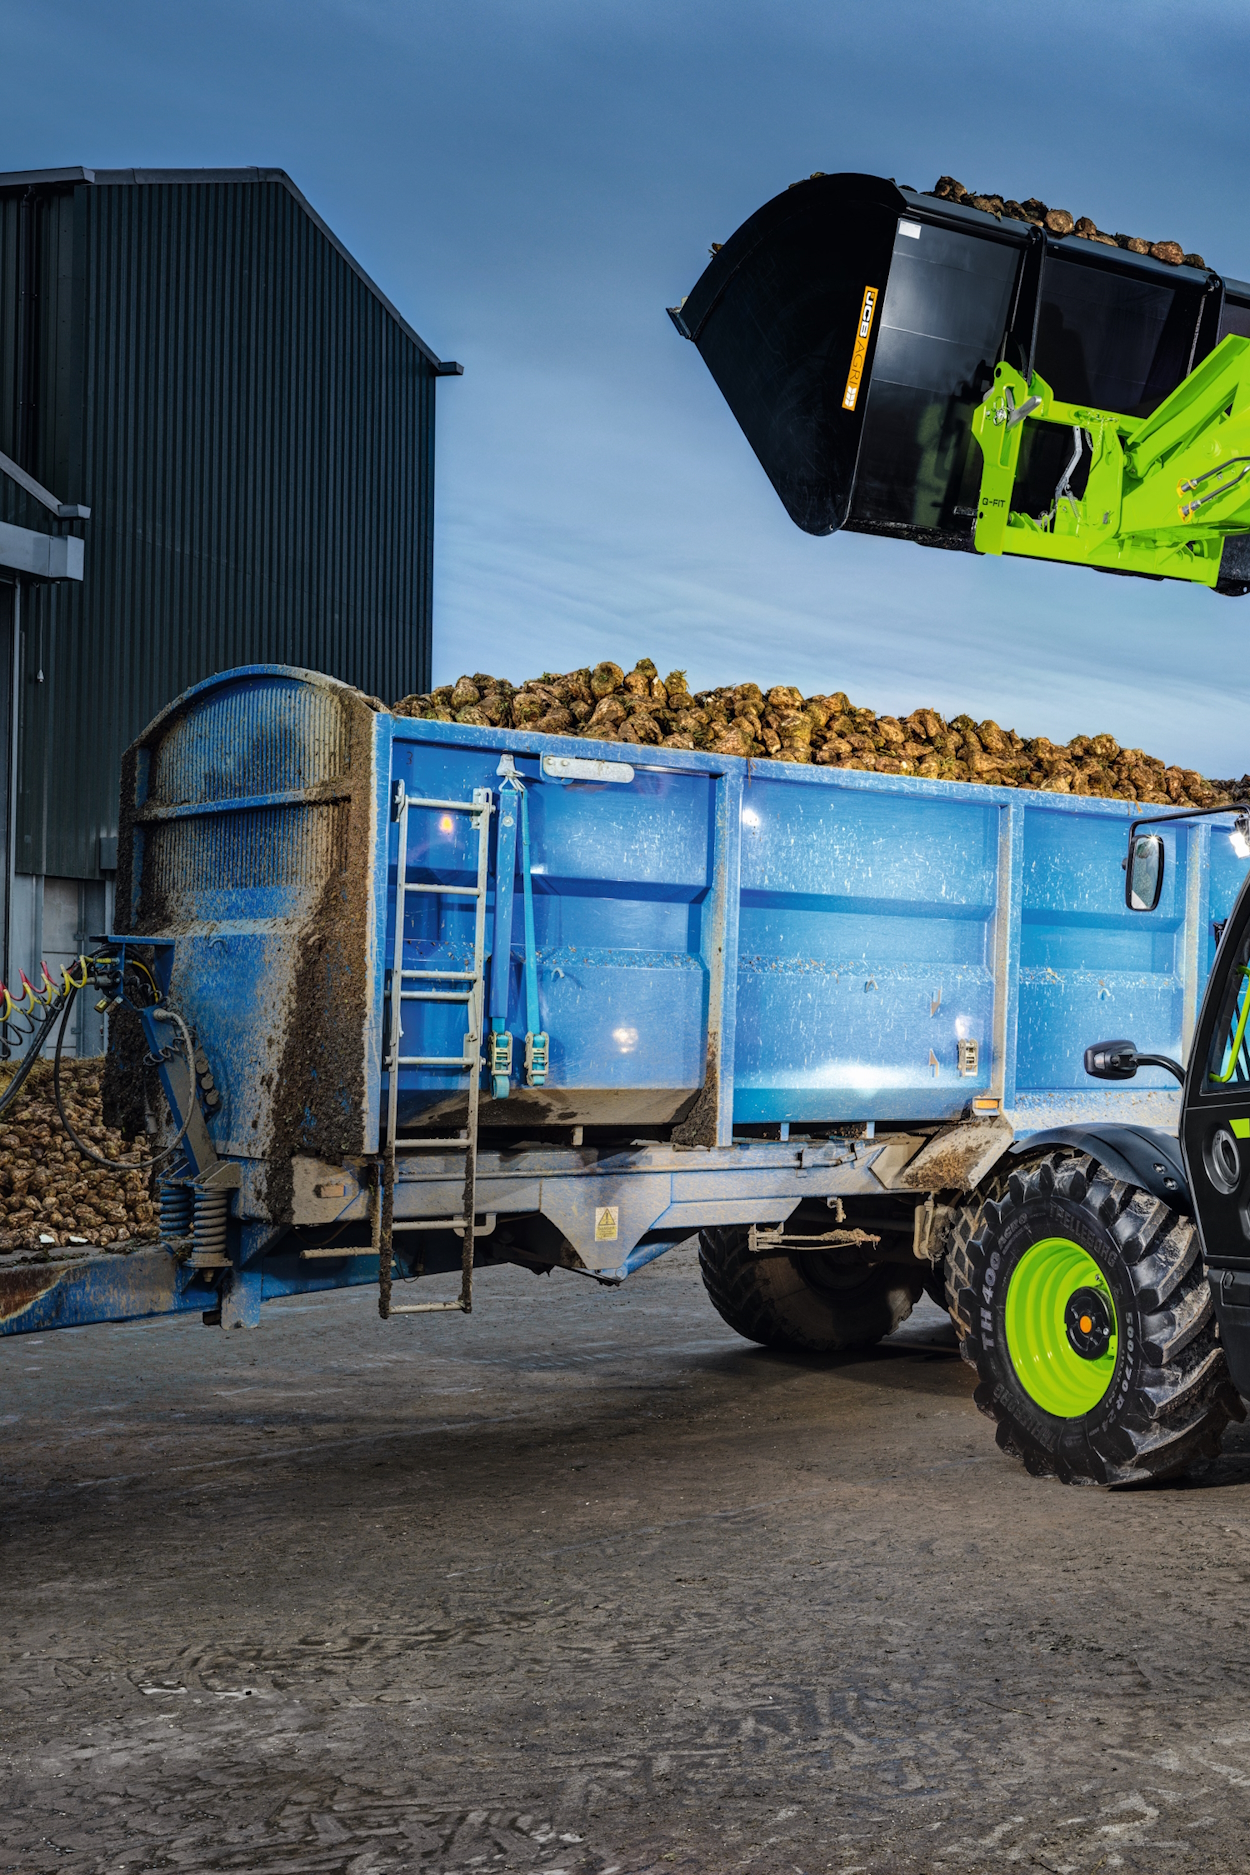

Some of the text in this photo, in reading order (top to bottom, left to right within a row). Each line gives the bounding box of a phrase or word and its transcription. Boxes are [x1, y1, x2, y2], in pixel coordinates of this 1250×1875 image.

[849, 291, 874, 386] JCB AGRI
[982, 1250, 1002, 1305] 400
[980, 1306, 995, 1351] TH
[1121, 1311, 1135, 1393] 500/70
